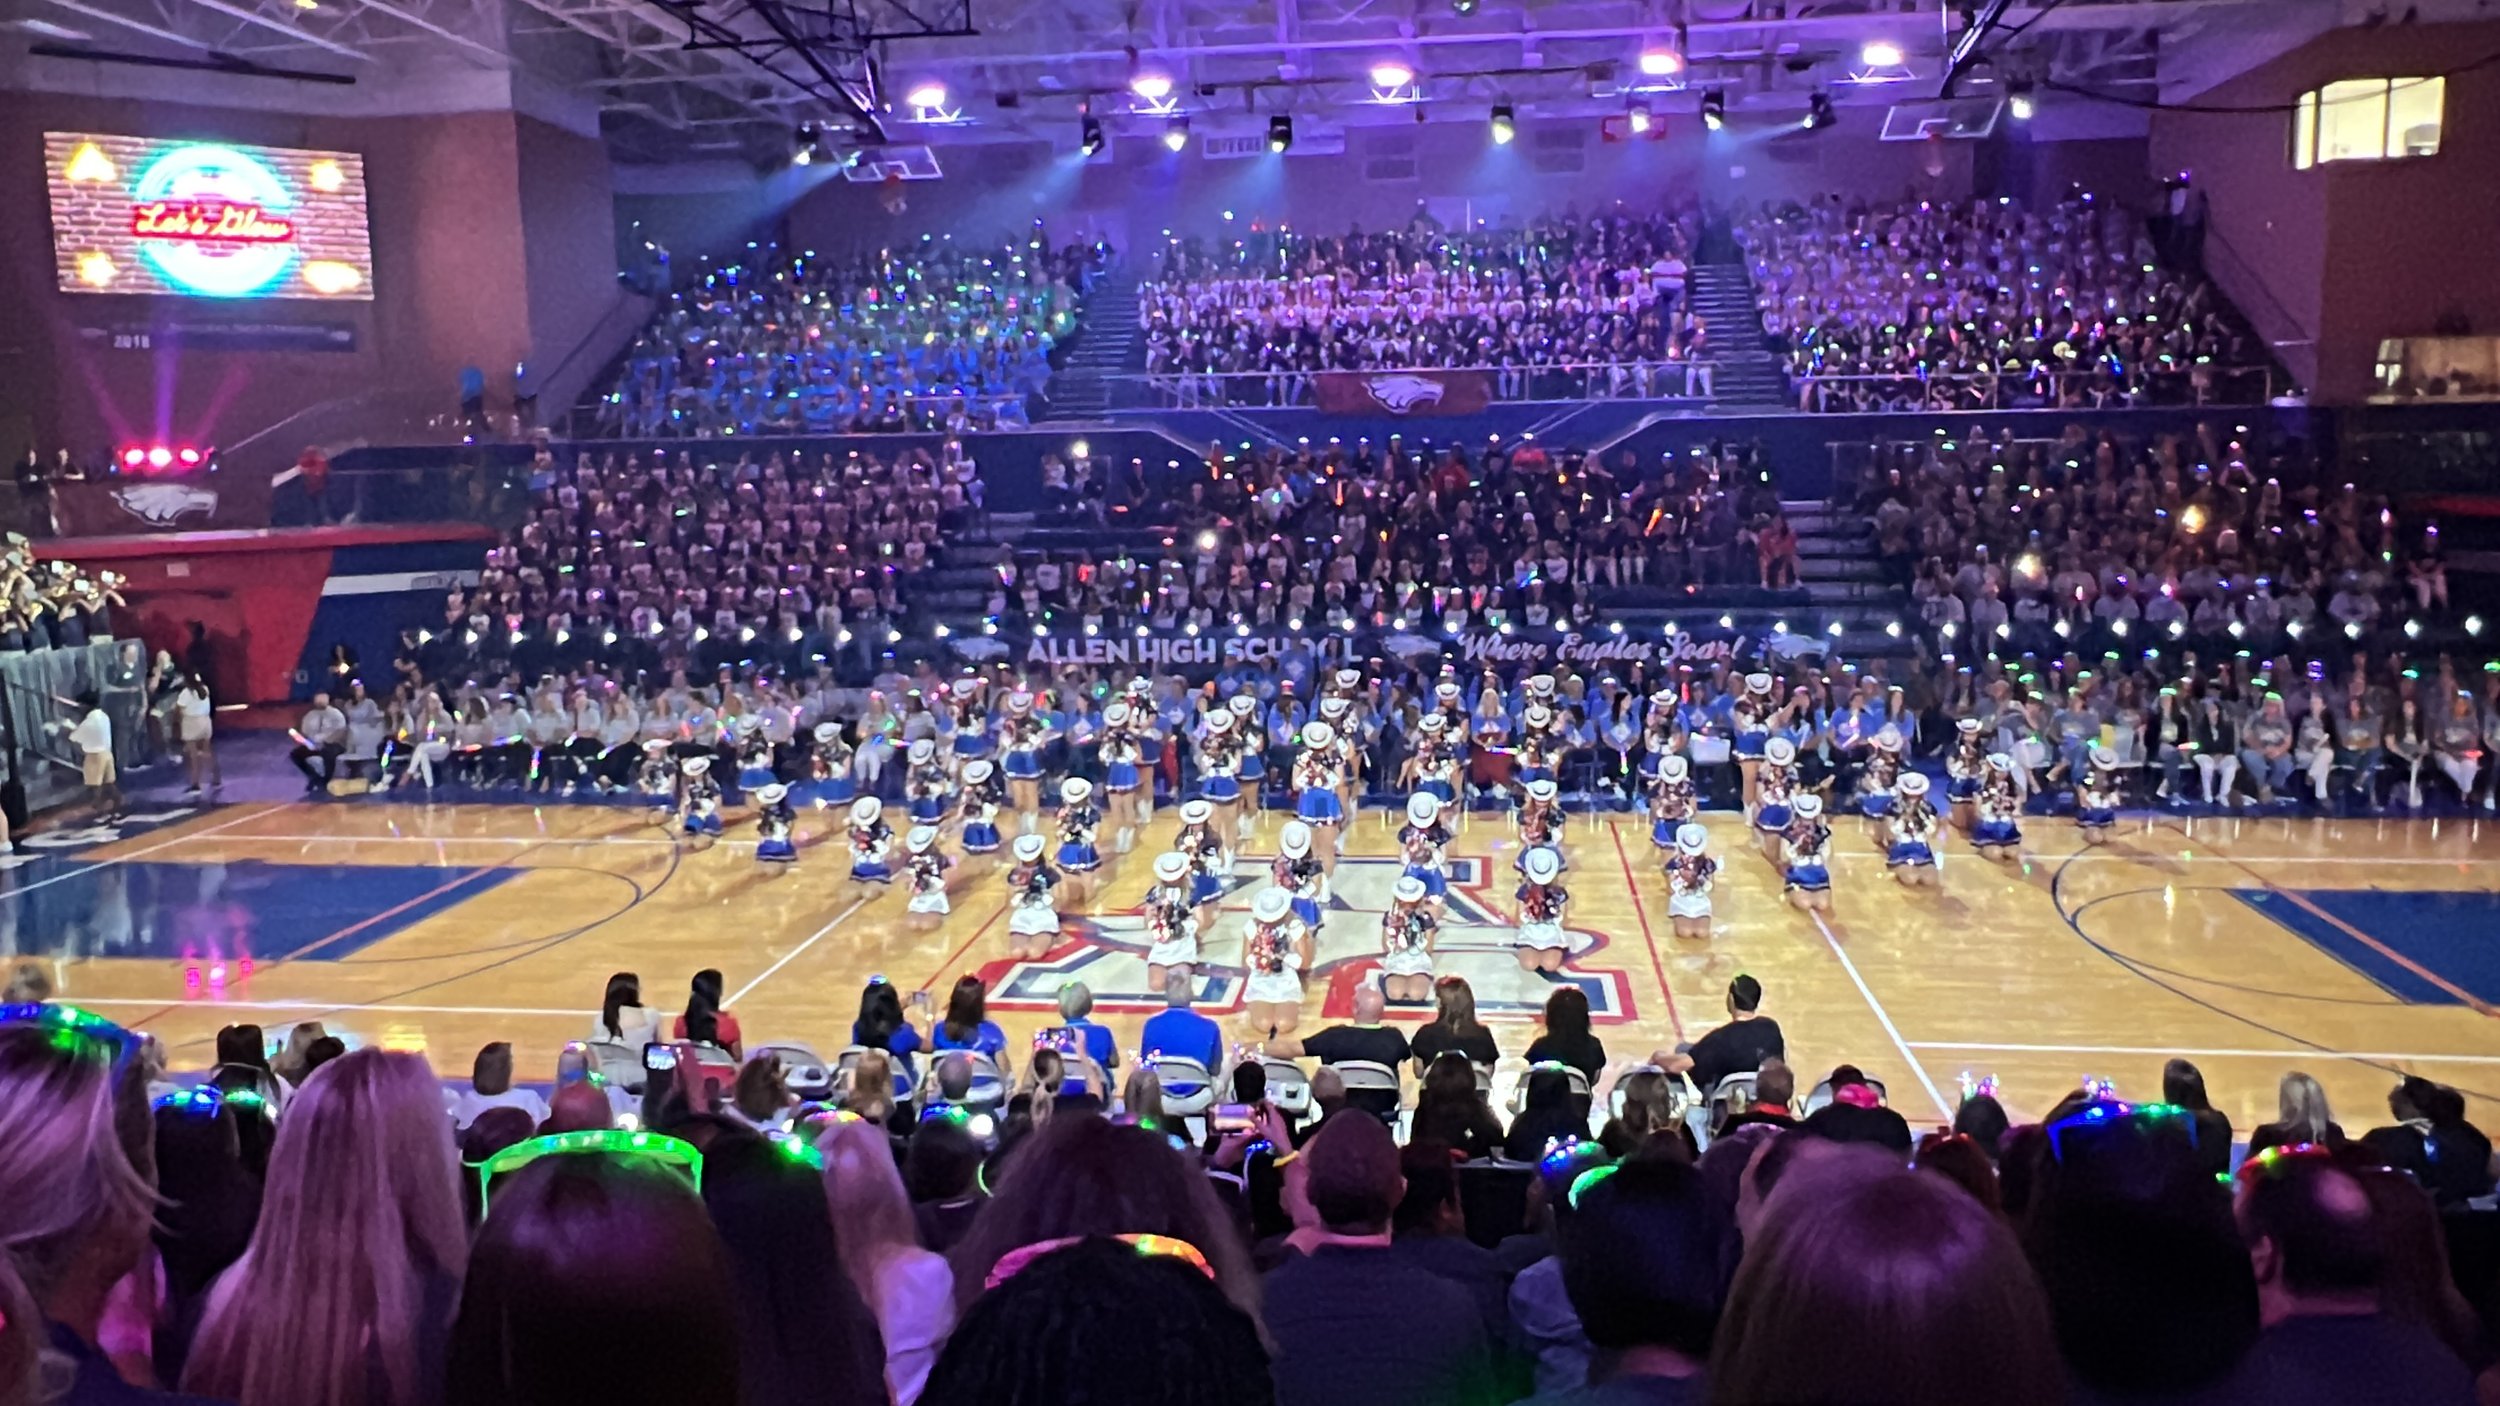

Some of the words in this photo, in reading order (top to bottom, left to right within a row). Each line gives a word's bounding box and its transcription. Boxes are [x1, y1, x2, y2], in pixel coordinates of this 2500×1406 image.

[136, 203, 208, 235] Let's
[210, 205, 290, 237] Glow
[1027, 637, 1131, 664] ALLEN
[1138, 637, 1217, 664] HIGH
[1456, 631, 1547, 661] Where
[1556, 632, 1652, 662] Eagles
[1658, 631, 1746, 661] Soar!
